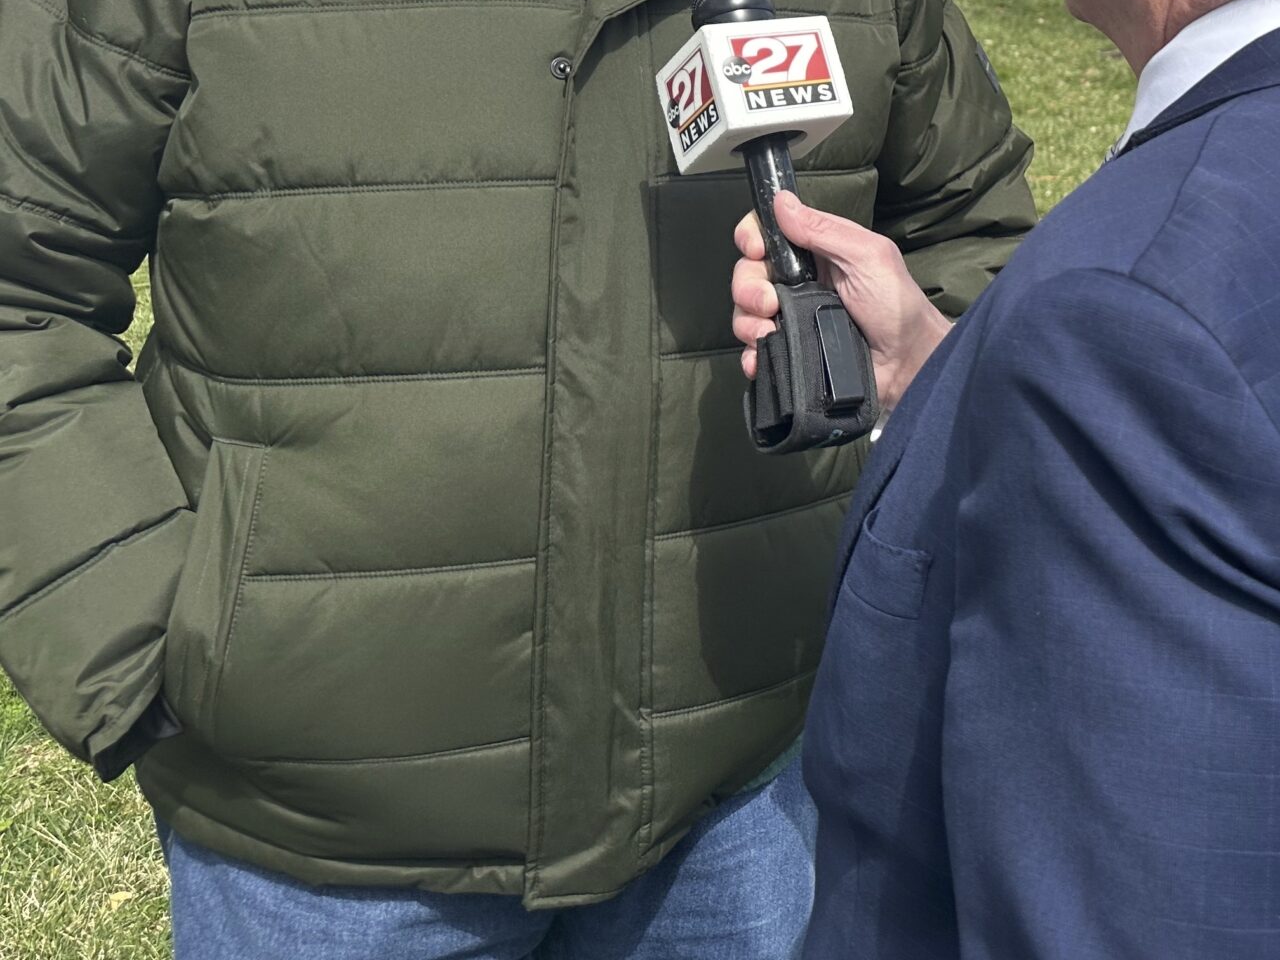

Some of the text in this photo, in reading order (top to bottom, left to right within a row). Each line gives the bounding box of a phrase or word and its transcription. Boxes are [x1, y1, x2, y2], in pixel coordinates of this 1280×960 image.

[722, 34, 818, 84] abc 27
[668, 51, 704, 124] abc 27
[750, 84, 833, 109] NEWS
[681, 105, 718, 150] NEWS
